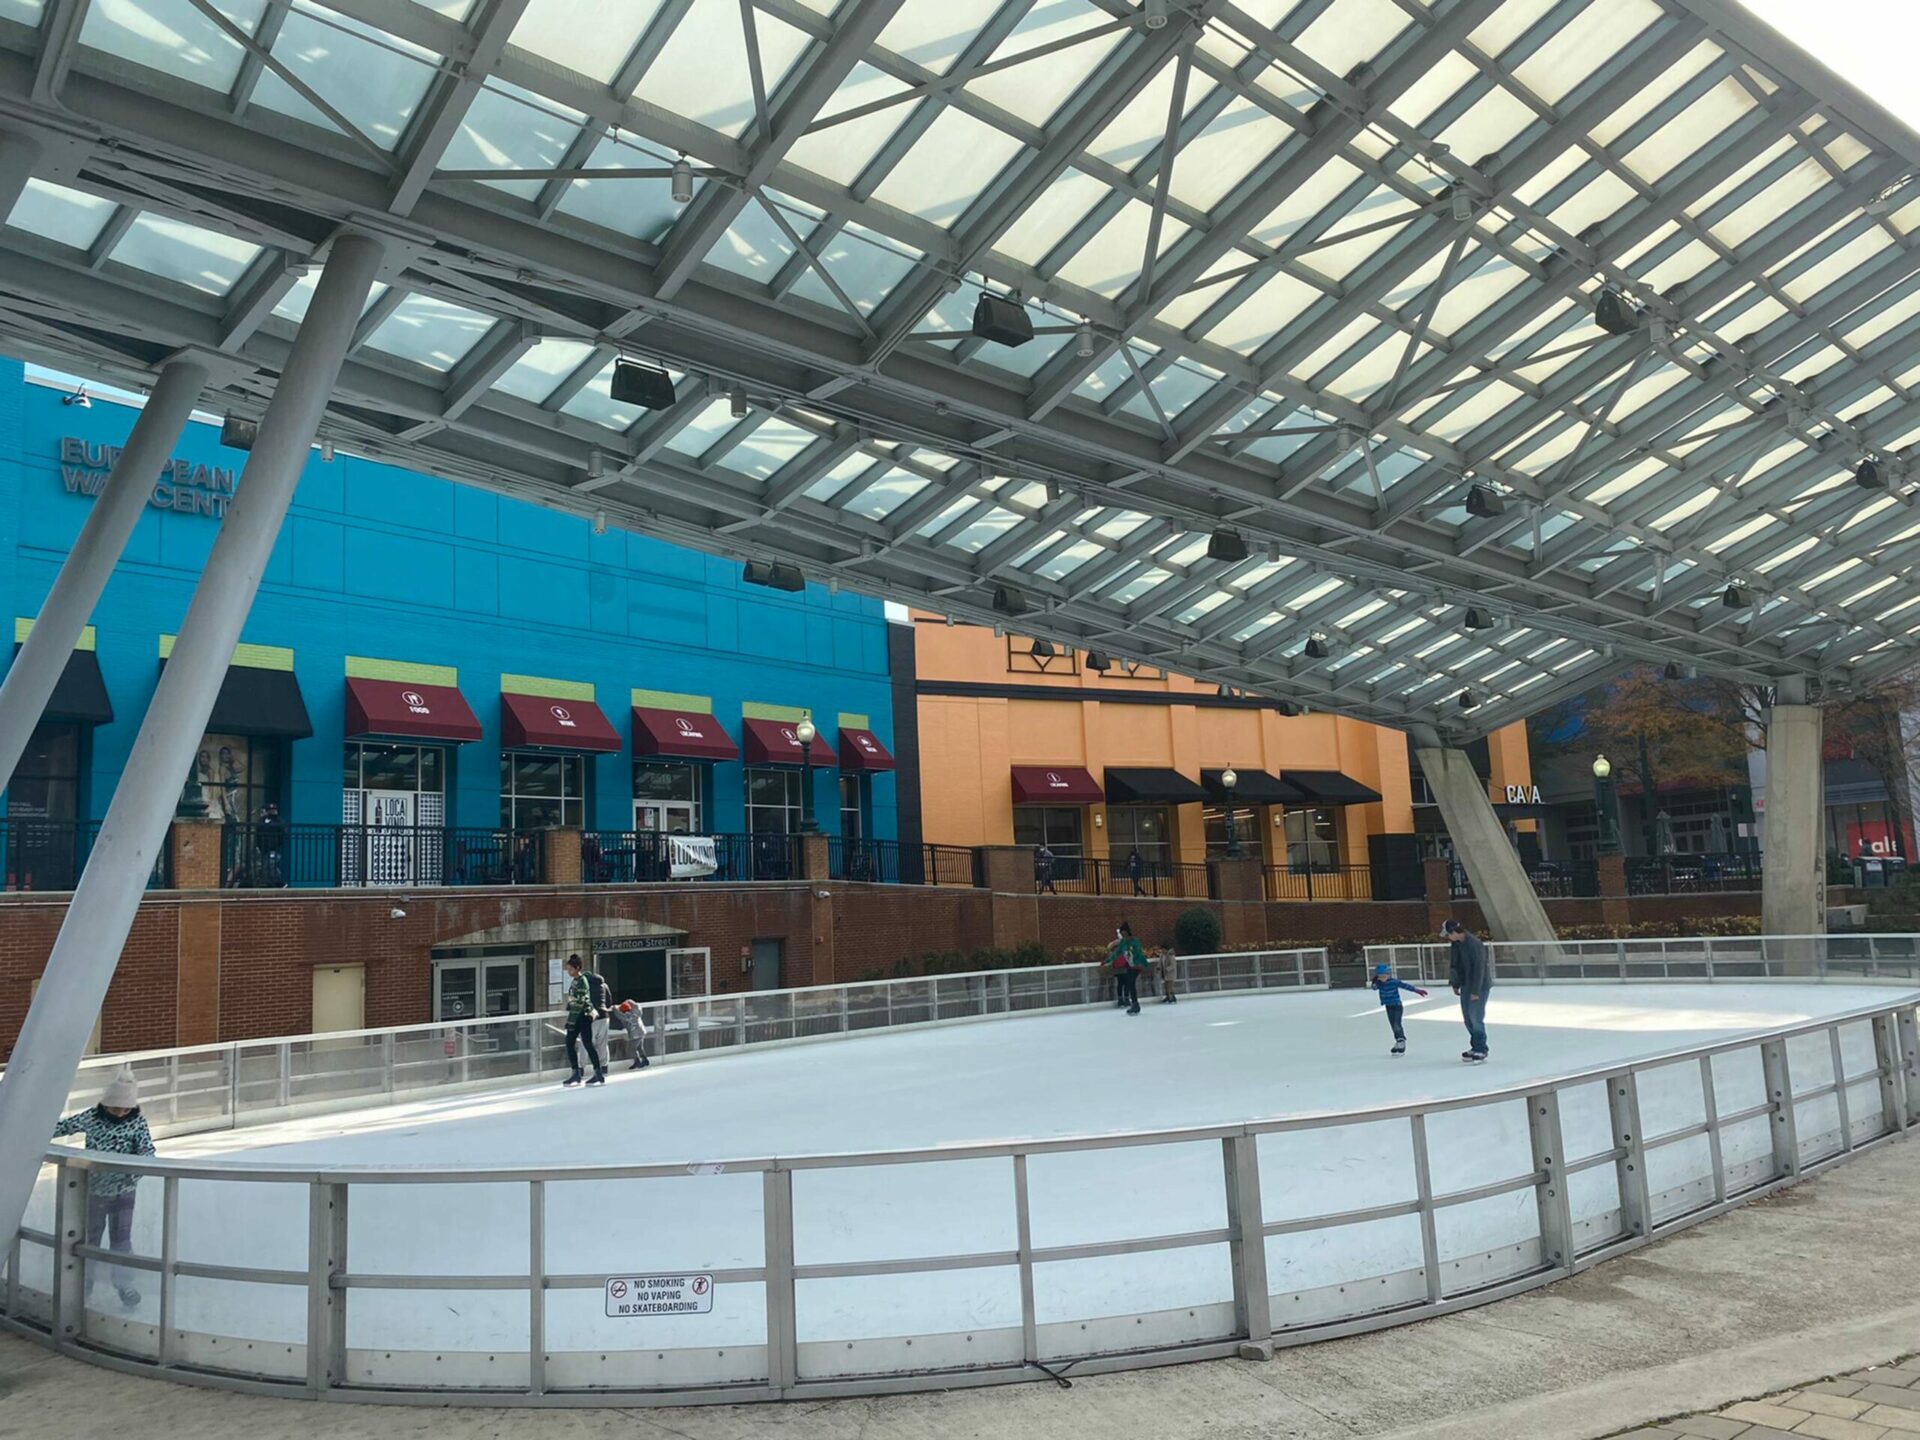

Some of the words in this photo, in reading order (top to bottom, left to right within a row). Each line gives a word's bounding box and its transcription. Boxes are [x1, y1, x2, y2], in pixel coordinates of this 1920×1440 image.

[61, 436, 235, 494] EURPEAN
[150, 483, 233, 520] CENT
[1506, 785, 1541, 803] CAVA
[385, 799, 405, 816] LOCA
[612, 939, 643, 949] Fenton
[645, 937, 672, 947] Street
[634, 1280, 646, 1289] NO
[648, 1278, 685, 1288] SMOKING
[637, 1292, 649, 1301] NO
[651, 1290, 681, 1300] VAPING
[619, 1305, 630, 1314] NO
[632, 1302, 698, 1313] SKATEBOARDING
